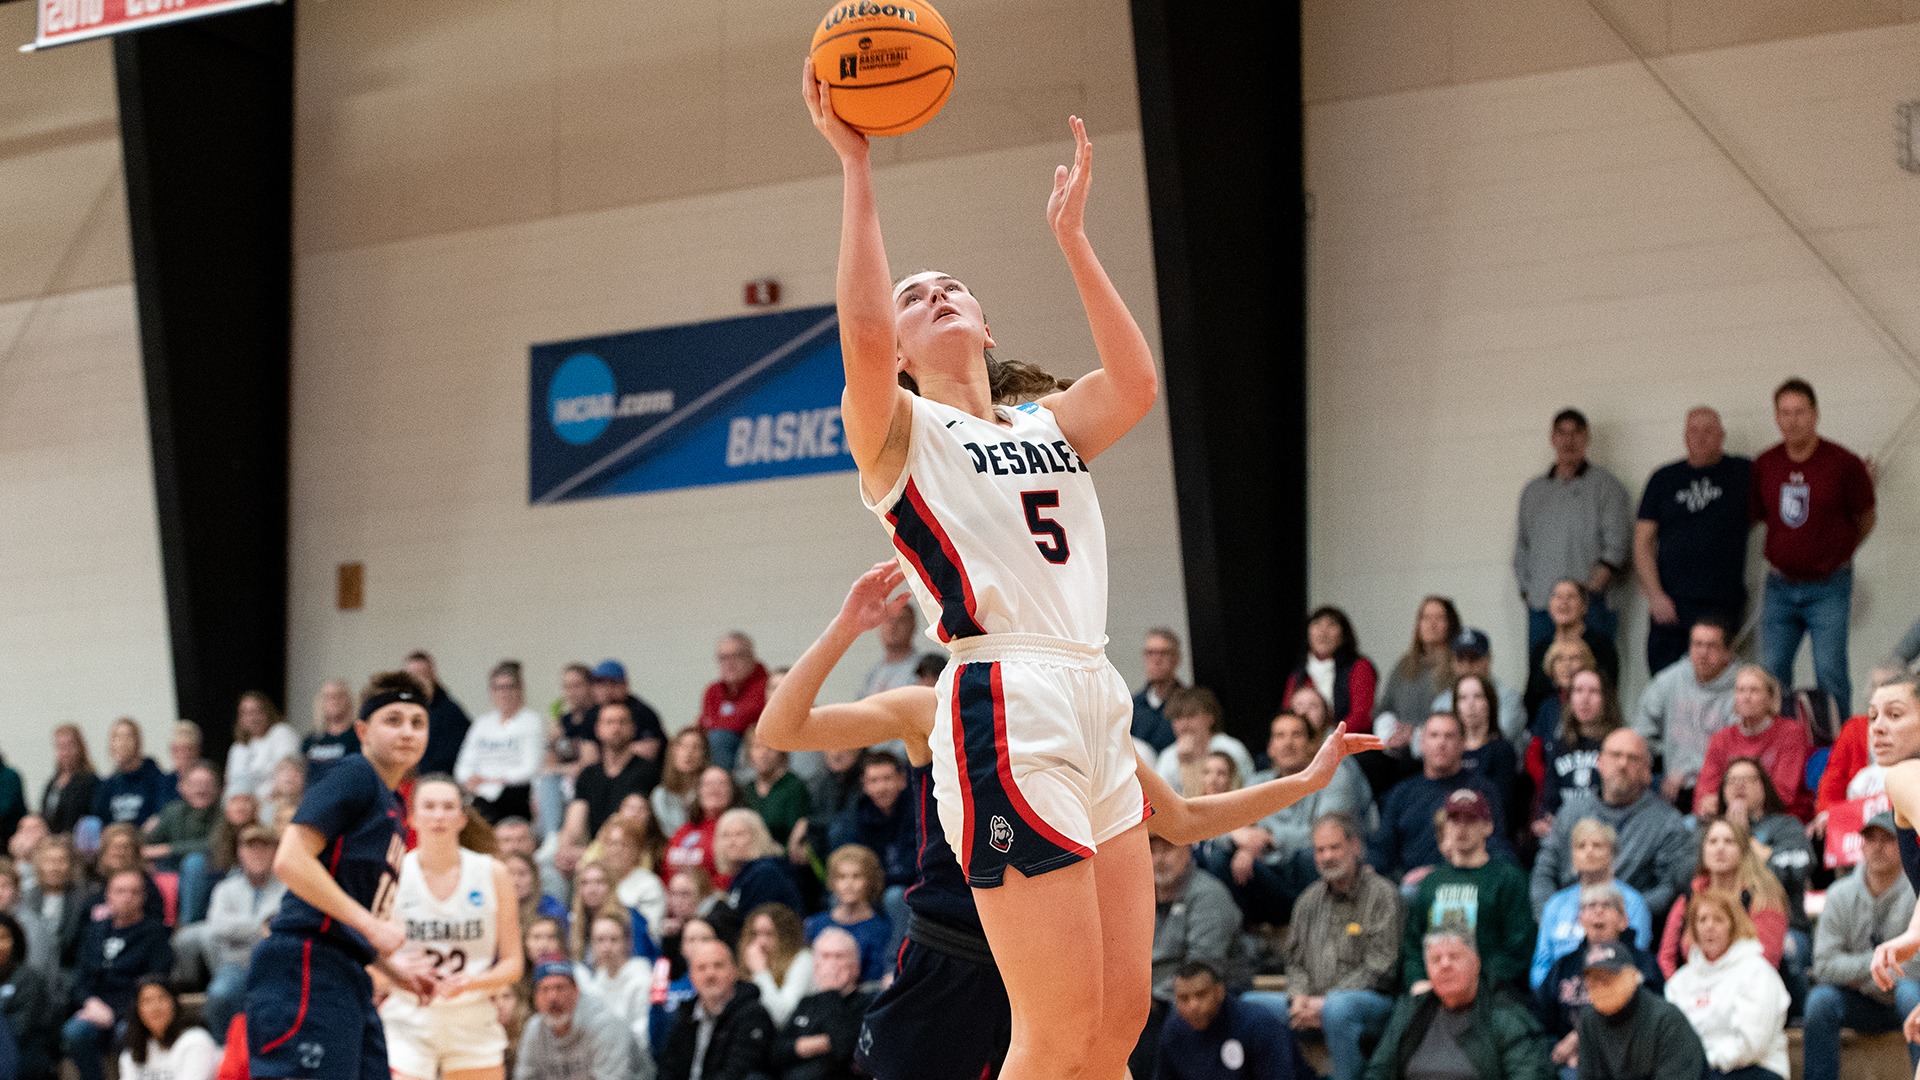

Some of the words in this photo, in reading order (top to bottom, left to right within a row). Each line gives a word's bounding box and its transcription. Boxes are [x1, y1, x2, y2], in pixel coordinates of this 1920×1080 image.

[825, 0, 917, 30] Wilson
[726, 406, 850, 467] BASKE
[1020, 490, 1070, 565] 5
